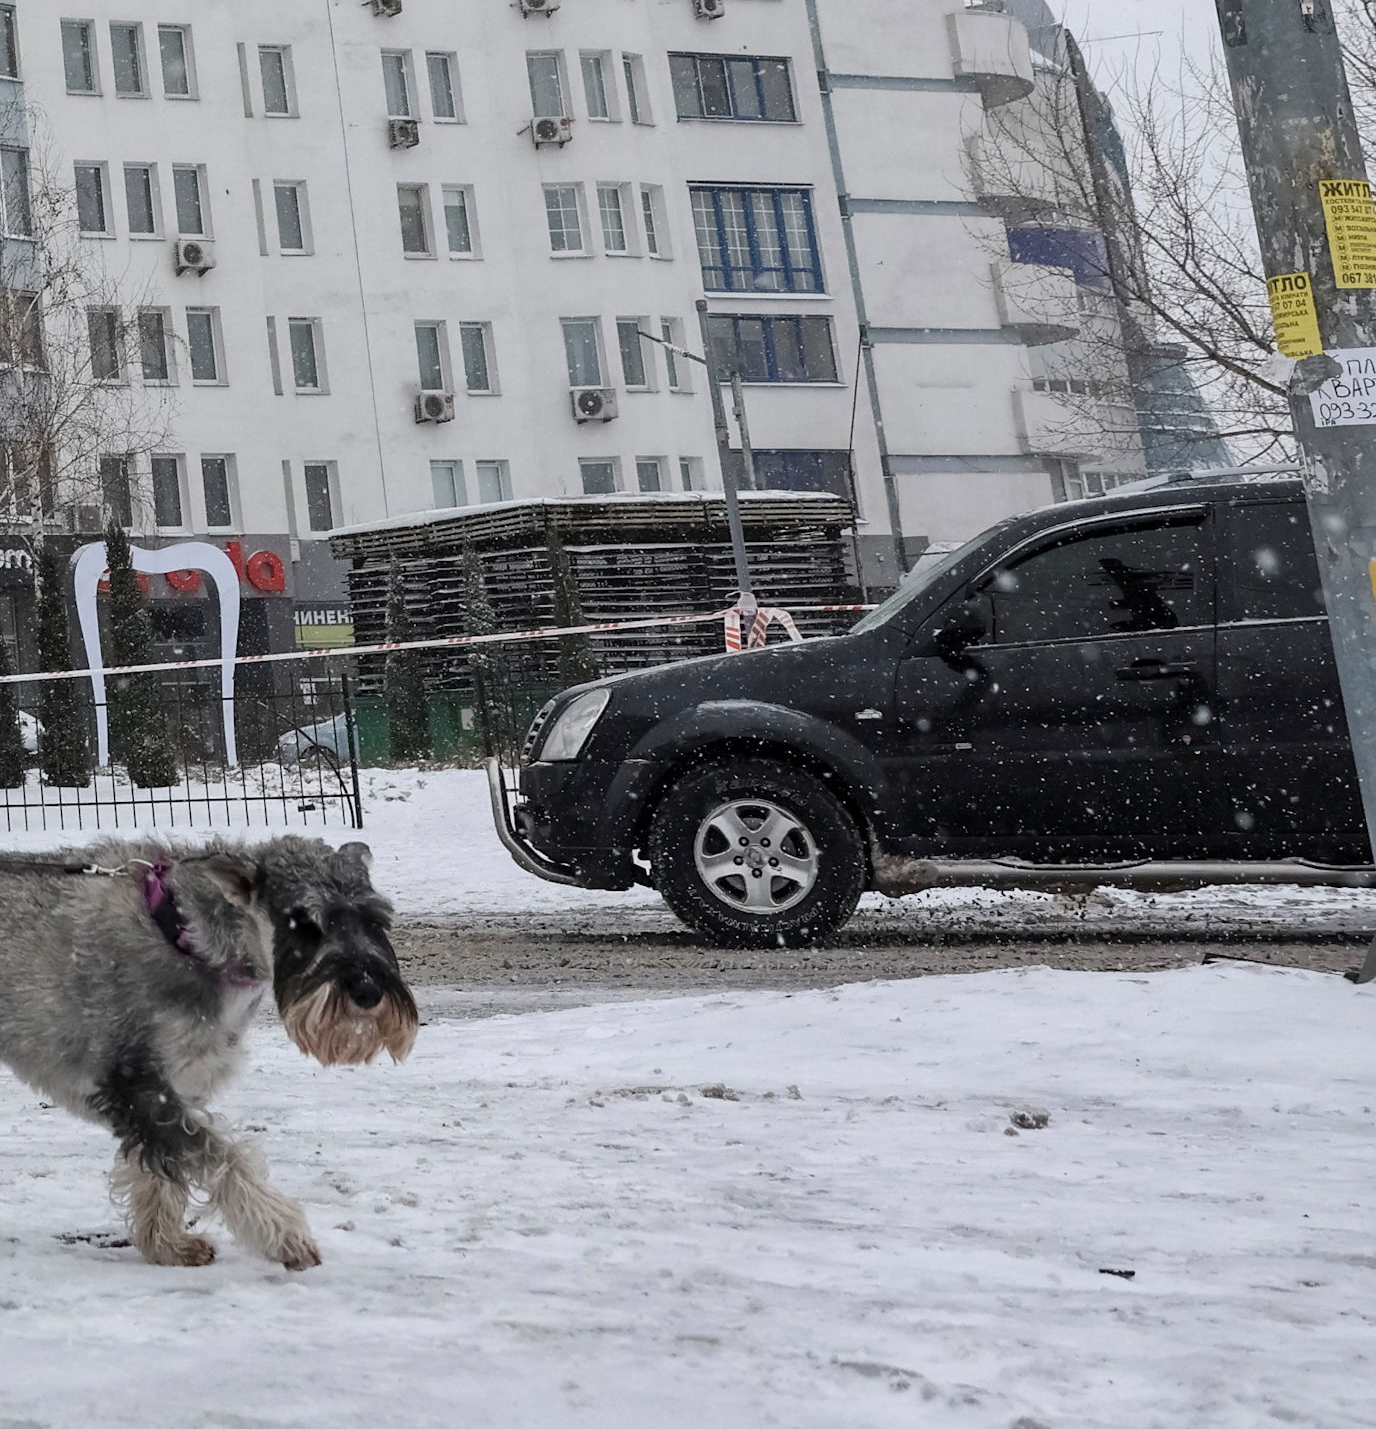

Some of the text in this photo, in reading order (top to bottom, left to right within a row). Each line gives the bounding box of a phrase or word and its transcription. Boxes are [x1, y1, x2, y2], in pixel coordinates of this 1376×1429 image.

[1321, 182, 1372, 198] ЖИТЛ
[1331, 205, 1350, 214] 093
[1270, 275, 1307, 293] ТЛО
[1342, 272, 1362, 284] 067
[1282, 300, 1292, 309] 07
[1295, 299, 1306, 308] 04
